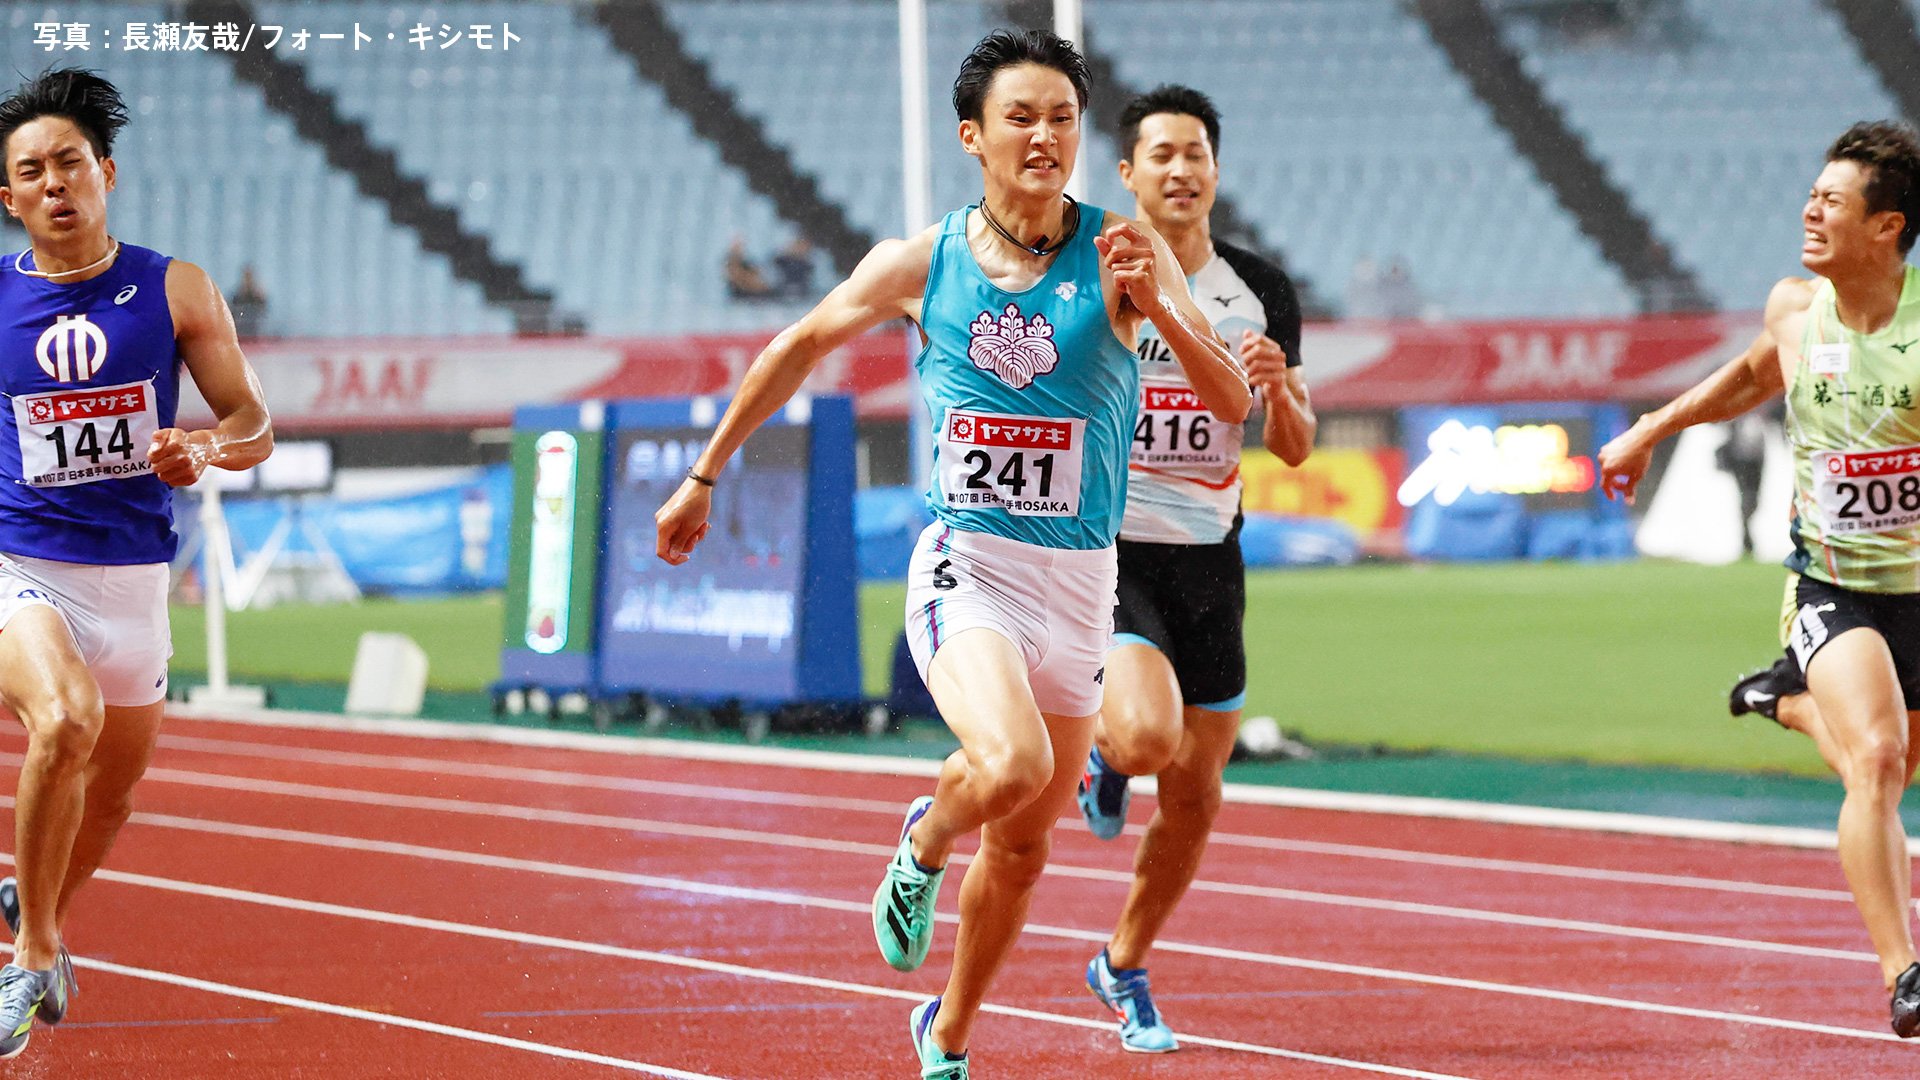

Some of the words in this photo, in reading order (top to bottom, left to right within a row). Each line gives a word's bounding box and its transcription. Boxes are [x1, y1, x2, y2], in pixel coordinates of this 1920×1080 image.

[1138, 338, 1172, 362] MIZ
[58, 393, 140, 416] ヤマザキ
[45, 418, 134, 469] 144
[980, 423, 1066, 444] ヤマザキ
[1133, 413, 1211, 451] 416
[963, 449, 1054, 498] 241
[1836, 475, 1920, 519] 208
[933, 558, 958, 591] 6
